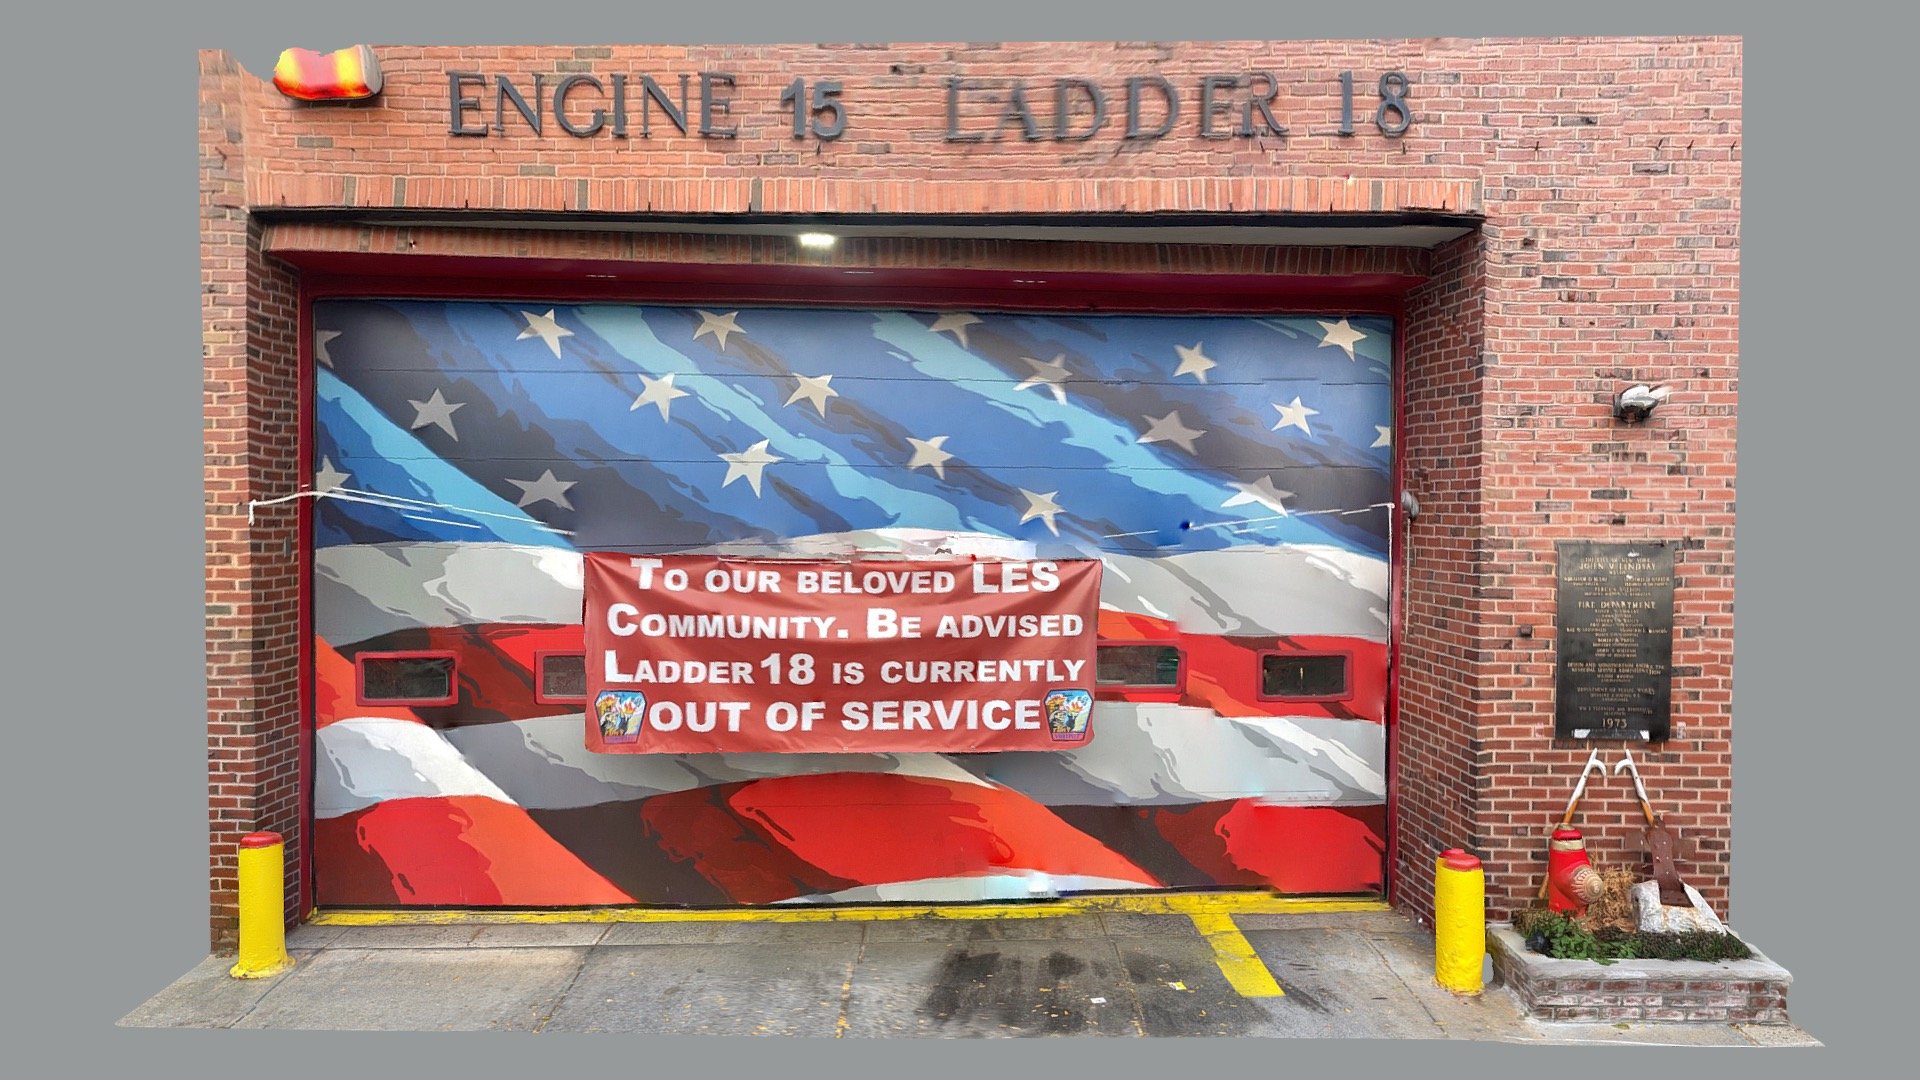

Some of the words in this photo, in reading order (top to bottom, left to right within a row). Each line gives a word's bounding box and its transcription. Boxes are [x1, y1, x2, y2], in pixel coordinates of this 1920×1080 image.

[446, 70, 737, 139] ENGINE
[779, 77, 847, 141] 15
[944, 71, 1289, 142] LADDER
[1338, 70, 1412, 138] 18
[630, 558, 689, 592] TO
[705, 569, 781, 593] OUR
[797, 571, 956, 594] BELOVED
[972, 561, 1060, 594] LES
[607, 603, 849, 639] COMMUNITY.
[867, 608, 921, 639] BE
[936, 614, 1083, 638] ADVISED
[1600, 601, 1656, 609] DEPARTMENT
[605, 650, 755, 684] LADDER
[761, 653, 815, 685] 18
[832, 662, 865, 684] IS
[881, 660, 1086, 684] CURRENTLY
[649, 701, 751, 732] OUT
[765, 701, 826, 732] OF
[841, 700, 1041, 731] SERVICE
